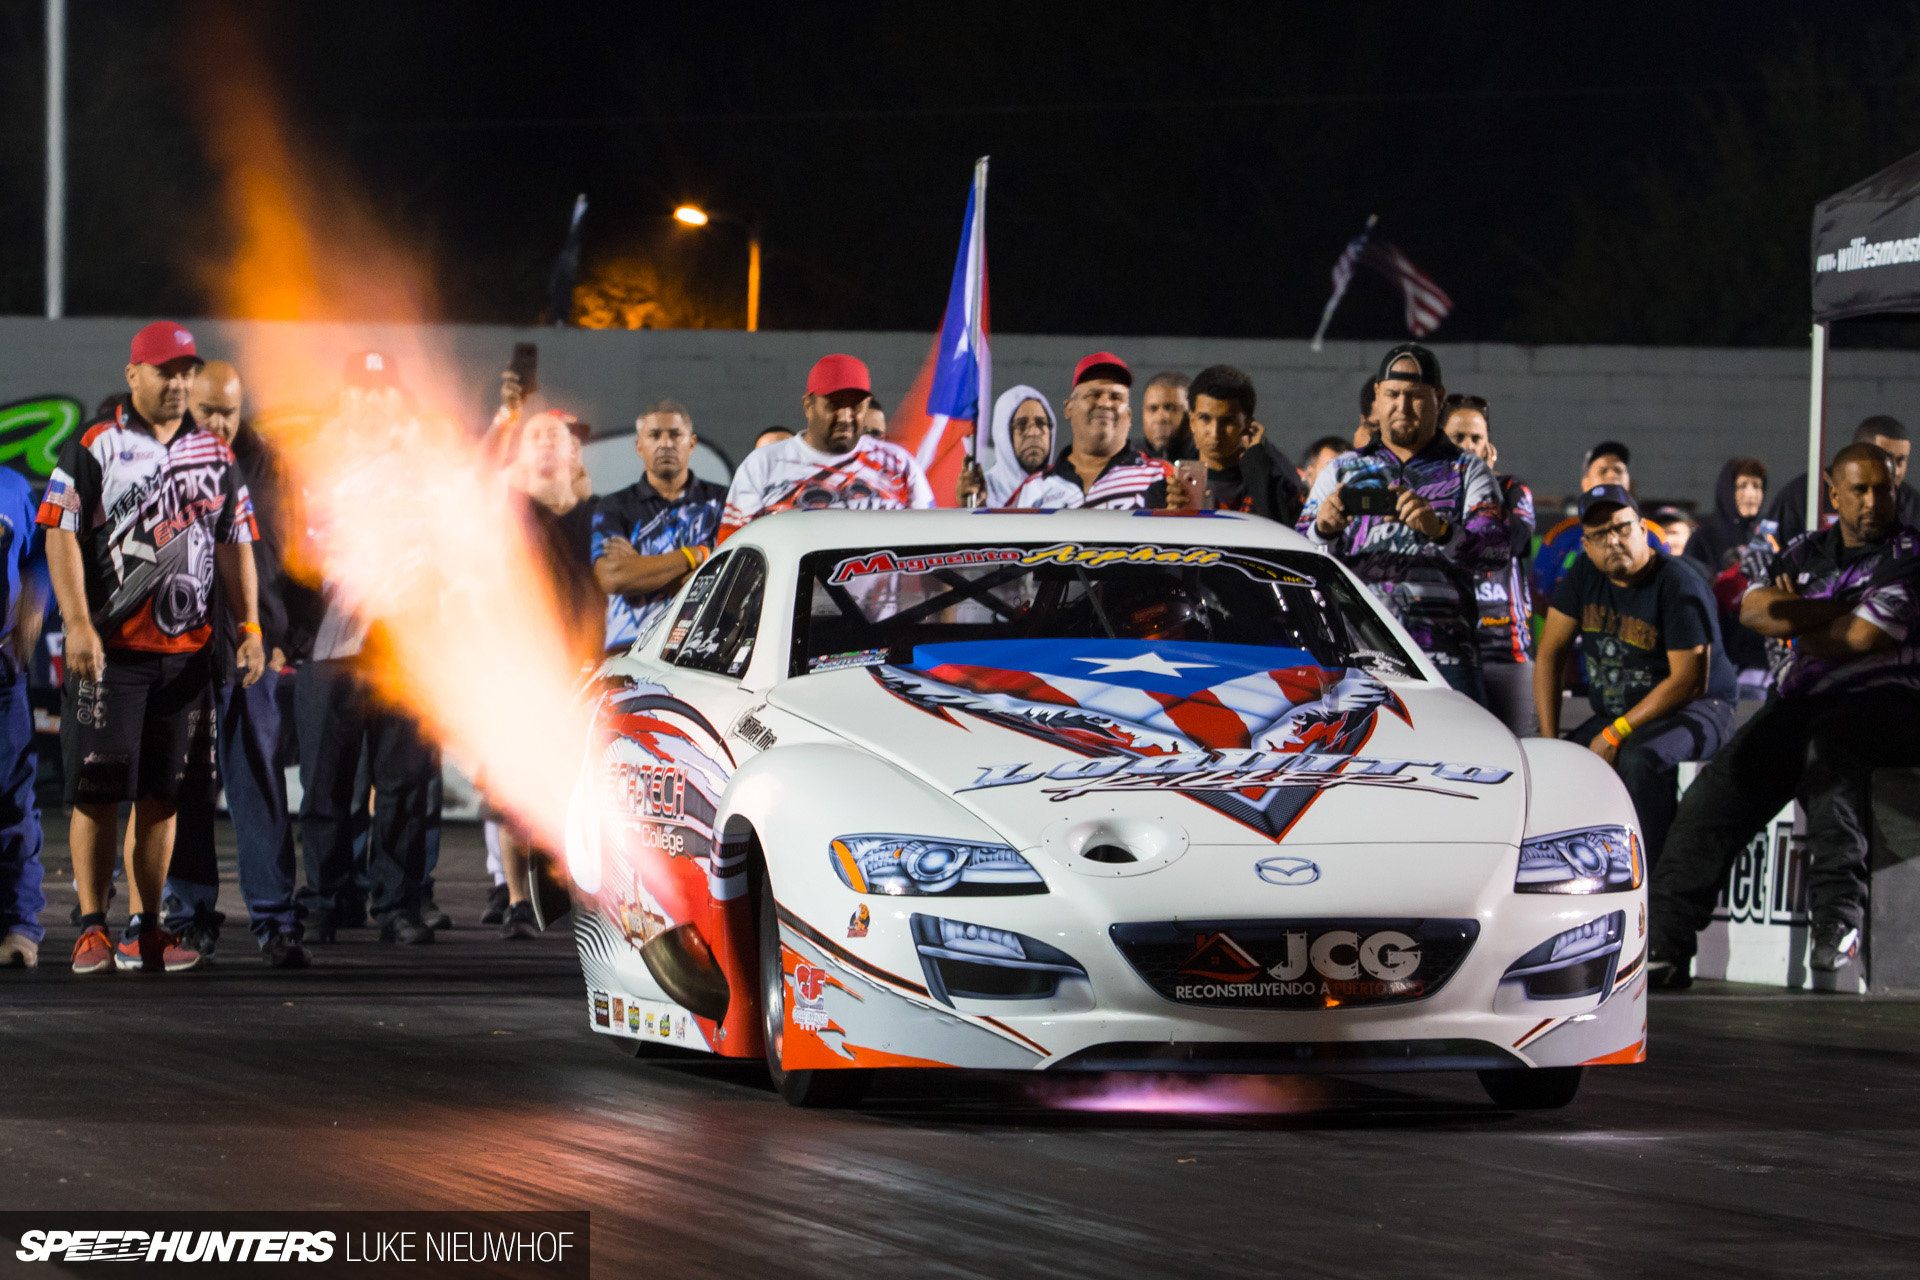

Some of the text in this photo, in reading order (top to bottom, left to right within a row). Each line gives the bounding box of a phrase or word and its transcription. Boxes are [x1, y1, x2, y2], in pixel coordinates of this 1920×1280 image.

[641, 824, 684, 856] College
[1267, 929, 1423, 981] JCG
[1175, 982, 1316, 999] RECONSTRUYENDO
[1320, 982, 1331, 995] A
